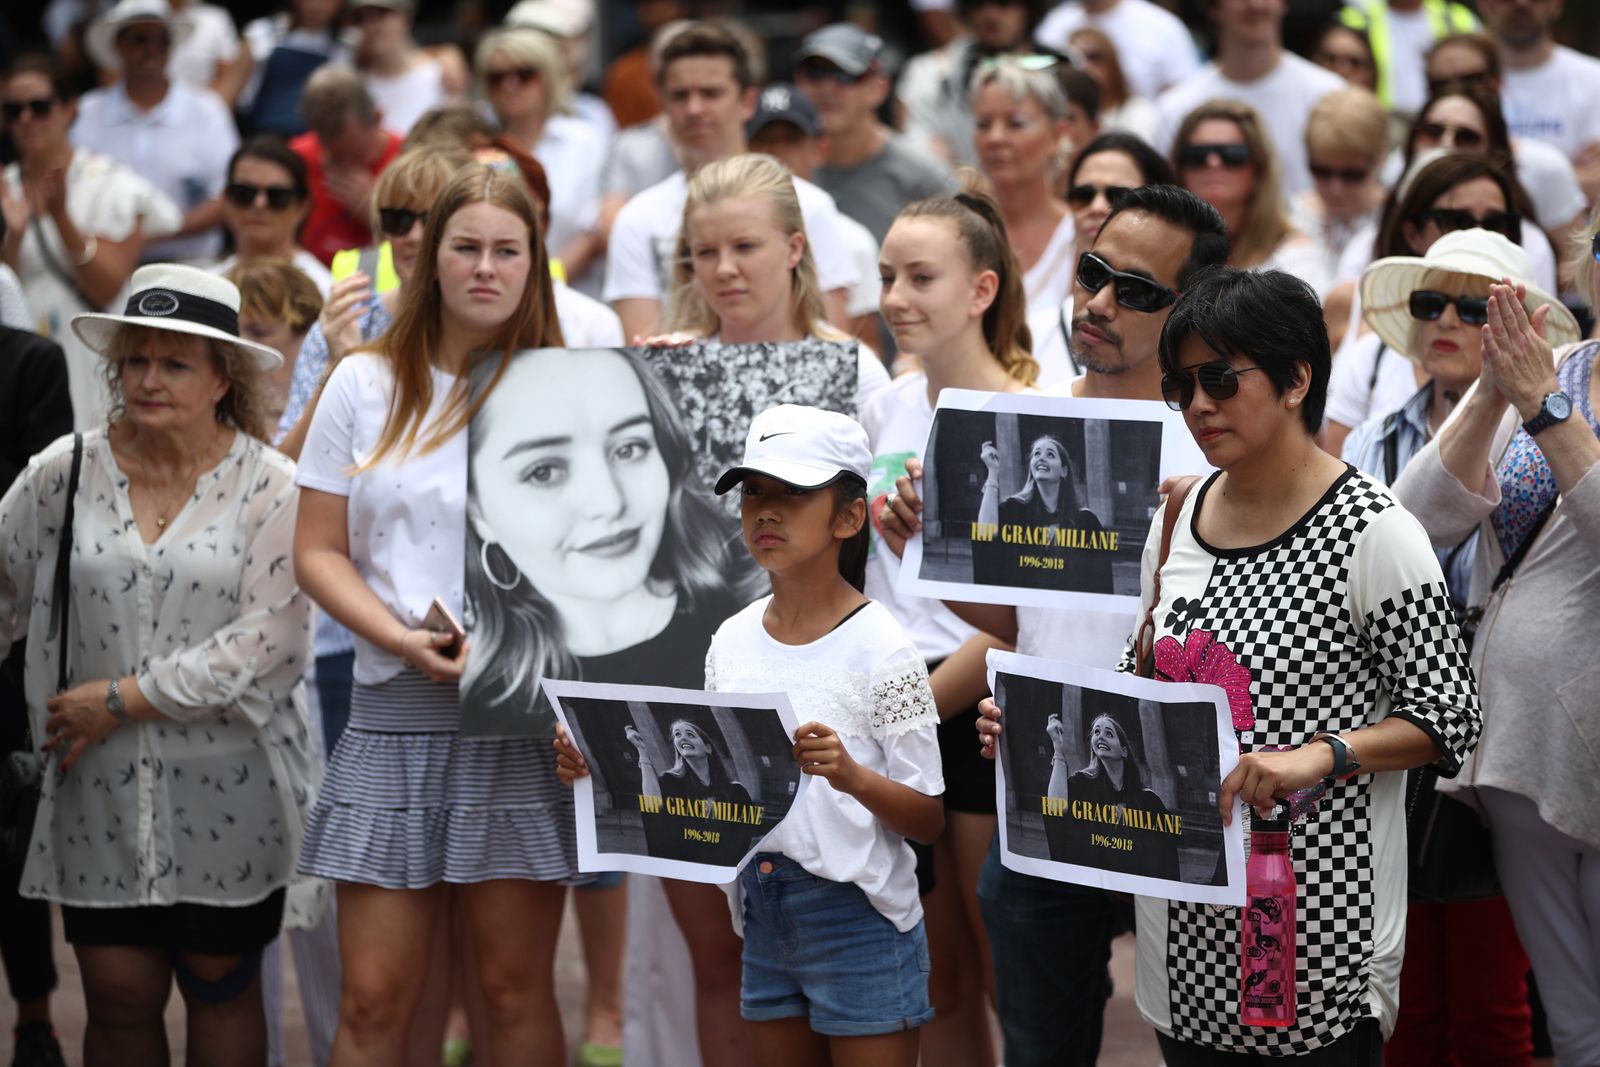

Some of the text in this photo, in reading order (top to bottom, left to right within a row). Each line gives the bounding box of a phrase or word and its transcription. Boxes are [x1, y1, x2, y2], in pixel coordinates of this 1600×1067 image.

[971, 522, 1119, 551] RIP GRACE MILLANE
[1019, 555, 1065, 570] 1996-2018
[638, 794, 765, 825] RIP GRACE MILLANE
[1041, 796, 1183, 835] RIP GRACE MILLANE
[684, 828, 720, 843] 1996-2018
[1091, 833, 1133, 851] 1996-2018
